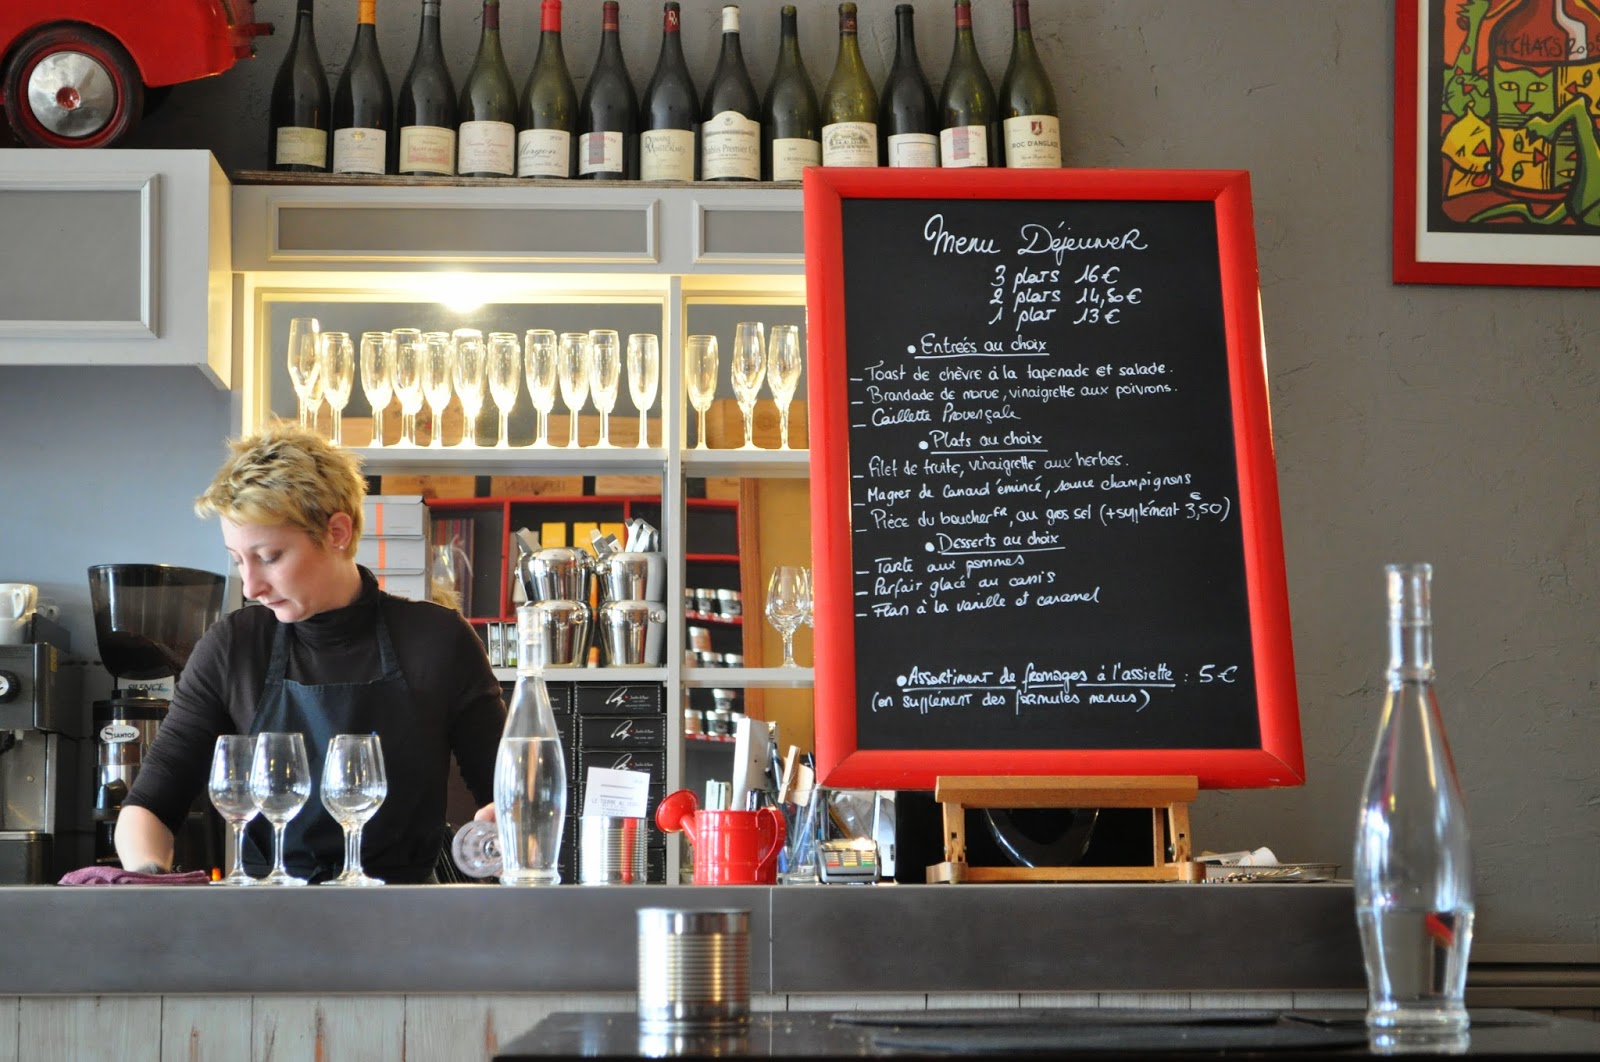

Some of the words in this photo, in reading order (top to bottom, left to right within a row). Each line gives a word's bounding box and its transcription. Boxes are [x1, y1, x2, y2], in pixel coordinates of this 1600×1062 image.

[924, 213, 1001, 256] Menu
[990, 264, 1006, 286] 3
[1012, 266, 1060, 293] plats
[989, 288, 1003, 304] 2
[1013, 288, 1061, 312] plats
[988, 306, 1003, 325] 1
[1016, 306, 1057, 331] plat
[984, 340, 1003, 352] au
[1010, 334, 1047, 352] choix
[864, 360, 906, 381] Toast
[913, 366, 930, 381] de
[939, 366, 982, 381] chèvre
[988, 366, 999, 380] à
[1002, 364, 1018, 380] la
[1026, 363, 1090, 381] tapenade
[1095, 364, 1113, 377] et
[866, 385, 935, 405] Brandade
[940, 387, 955, 400] de
[1009, 385, 1076, 403] vinaigrette
[1080, 386, 1109, 397] aux
[871, 406, 932, 427] Caillette
[942, 402, 1022, 425] Provençale
[928, 430, 972, 448] Plats
[979, 435, 999, 447] au
[1003, 430, 1042, 447] choix
[903, 460, 918, 476] de
[968, 455, 1036, 476] vinaigrette
[1044, 457, 1072, 469] aux
[918, 483, 934, 499] de
[942, 482, 990, 498] Canard
[1100, 471, 1192, 492] champignons
[870, 508, 910, 529] Pièce
[918, 510, 935, 526] du
[1016, 509, 1038, 522] au
[1046, 508, 1070, 526] gros
[1073, 504, 1092, 520] sel
[936, 532, 997, 551] Desserts
[1003, 534, 1021, 546] au
[1027, 531, 1059, 546] choix
[927, 561, 956, 573] aux
[966, 554, 1025, 579] pommes
[874, 576, 923, 599] Parfait
[929, 575, 967, 598] glacé
[979, 577, 999, 588] au
[872, 602, 909, 618] Flan
[916, 600, 927, 615] à
[934, 600, 949, 614] la
[957, 592, 1006, 613] vanille
[1015, 590, 1030, 607] et
[1036, 586, 1100, 607] caramel
[999, 666, 1016, 684] de
[1021, 662, 1088, 694] fromages
[1097, 665, 1106, 681] à
[1112, 662, 1174, 681] l'assiette
[1199, 664, 1238, 684] 5€
[871, 692, 893, 712] (en
[982, 692, 1006, 707] des
[1016, 689, 1080, 715] formules
